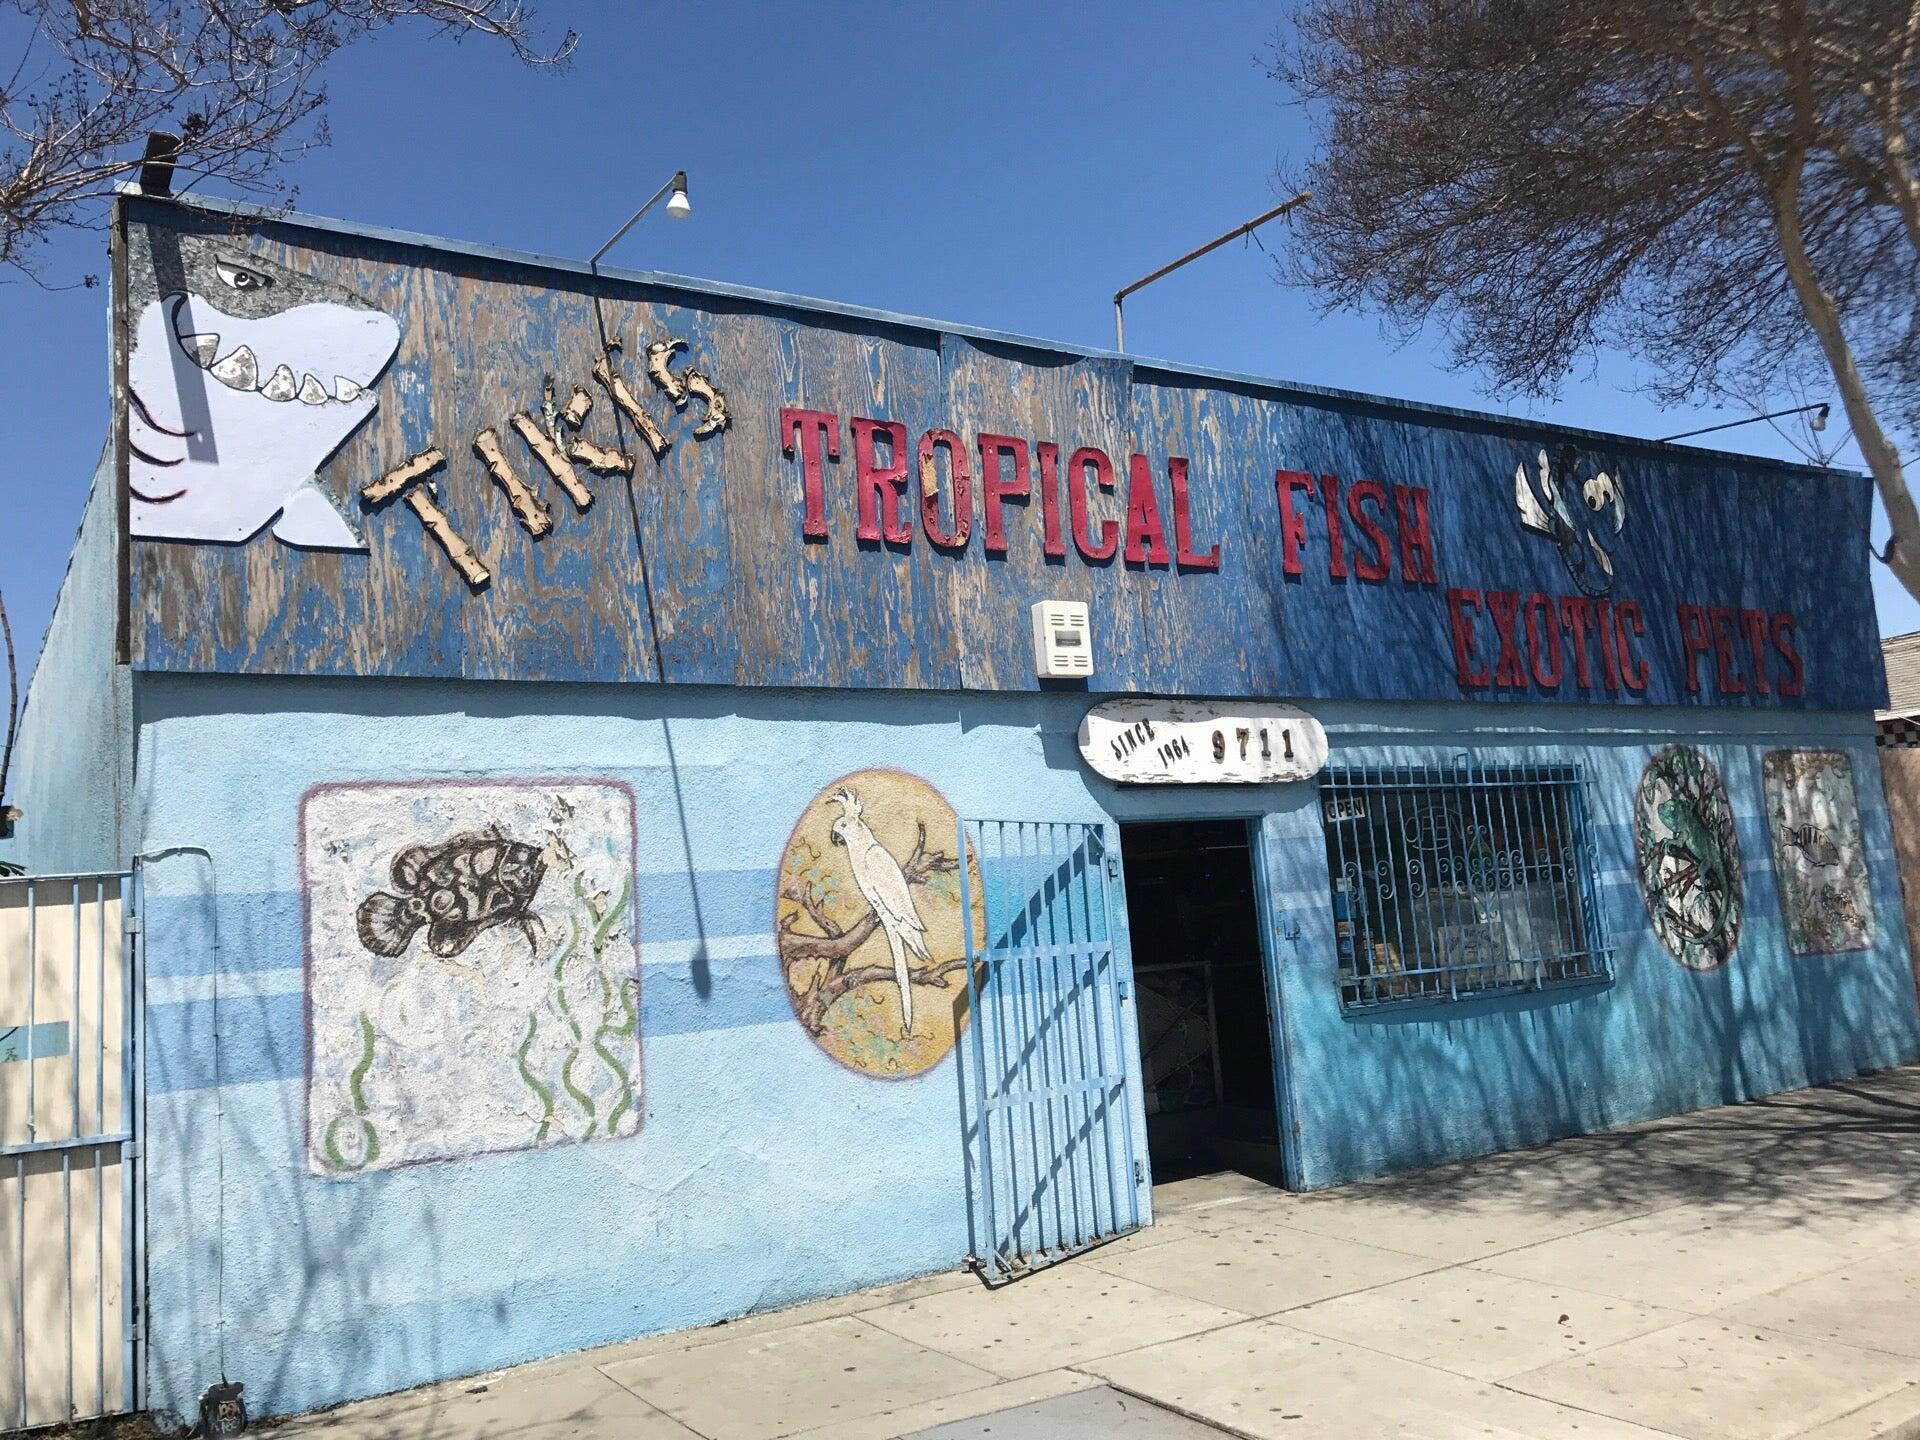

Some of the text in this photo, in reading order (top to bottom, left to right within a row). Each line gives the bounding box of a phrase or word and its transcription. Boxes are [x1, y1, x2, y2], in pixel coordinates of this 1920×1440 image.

[780, 407, 1438, 585] TROPICAL FISH
[1447, 588, 1804, 695] EXOTIC PETS
[1110, 717, 1156, 761] SINCE
[1157, 735, 1191, 769] 1964
[1212, 728, 1294, 764] 9711
[1327, 798, 1364, 819] OPEN
